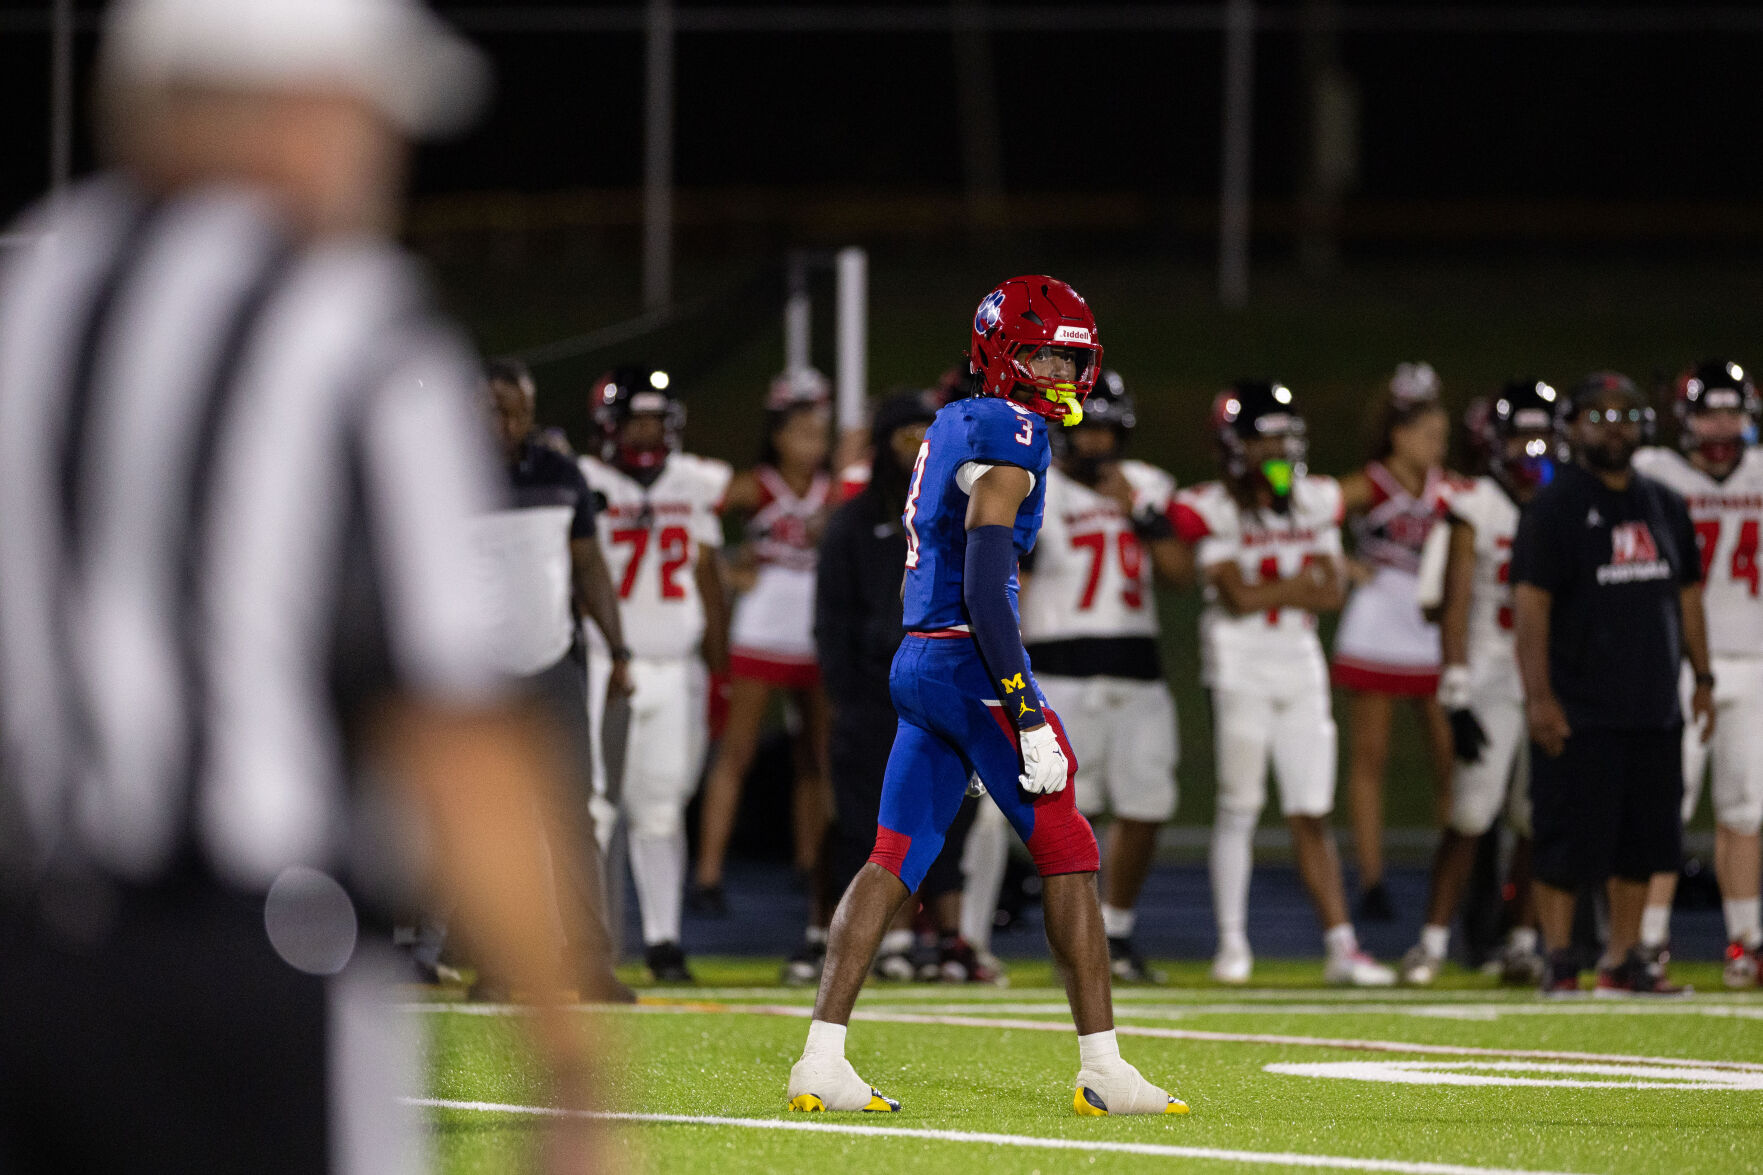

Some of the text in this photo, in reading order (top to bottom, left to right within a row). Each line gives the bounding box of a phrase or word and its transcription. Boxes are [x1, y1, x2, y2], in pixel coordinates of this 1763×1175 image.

[1015, 415, 1034, 446] 3
[612, 526, 689, 599] 72
[1071, 532, 1142, 608] 79
[1692, 519, 1757, 597] 74
[1001, 672, 1026, 694] M
